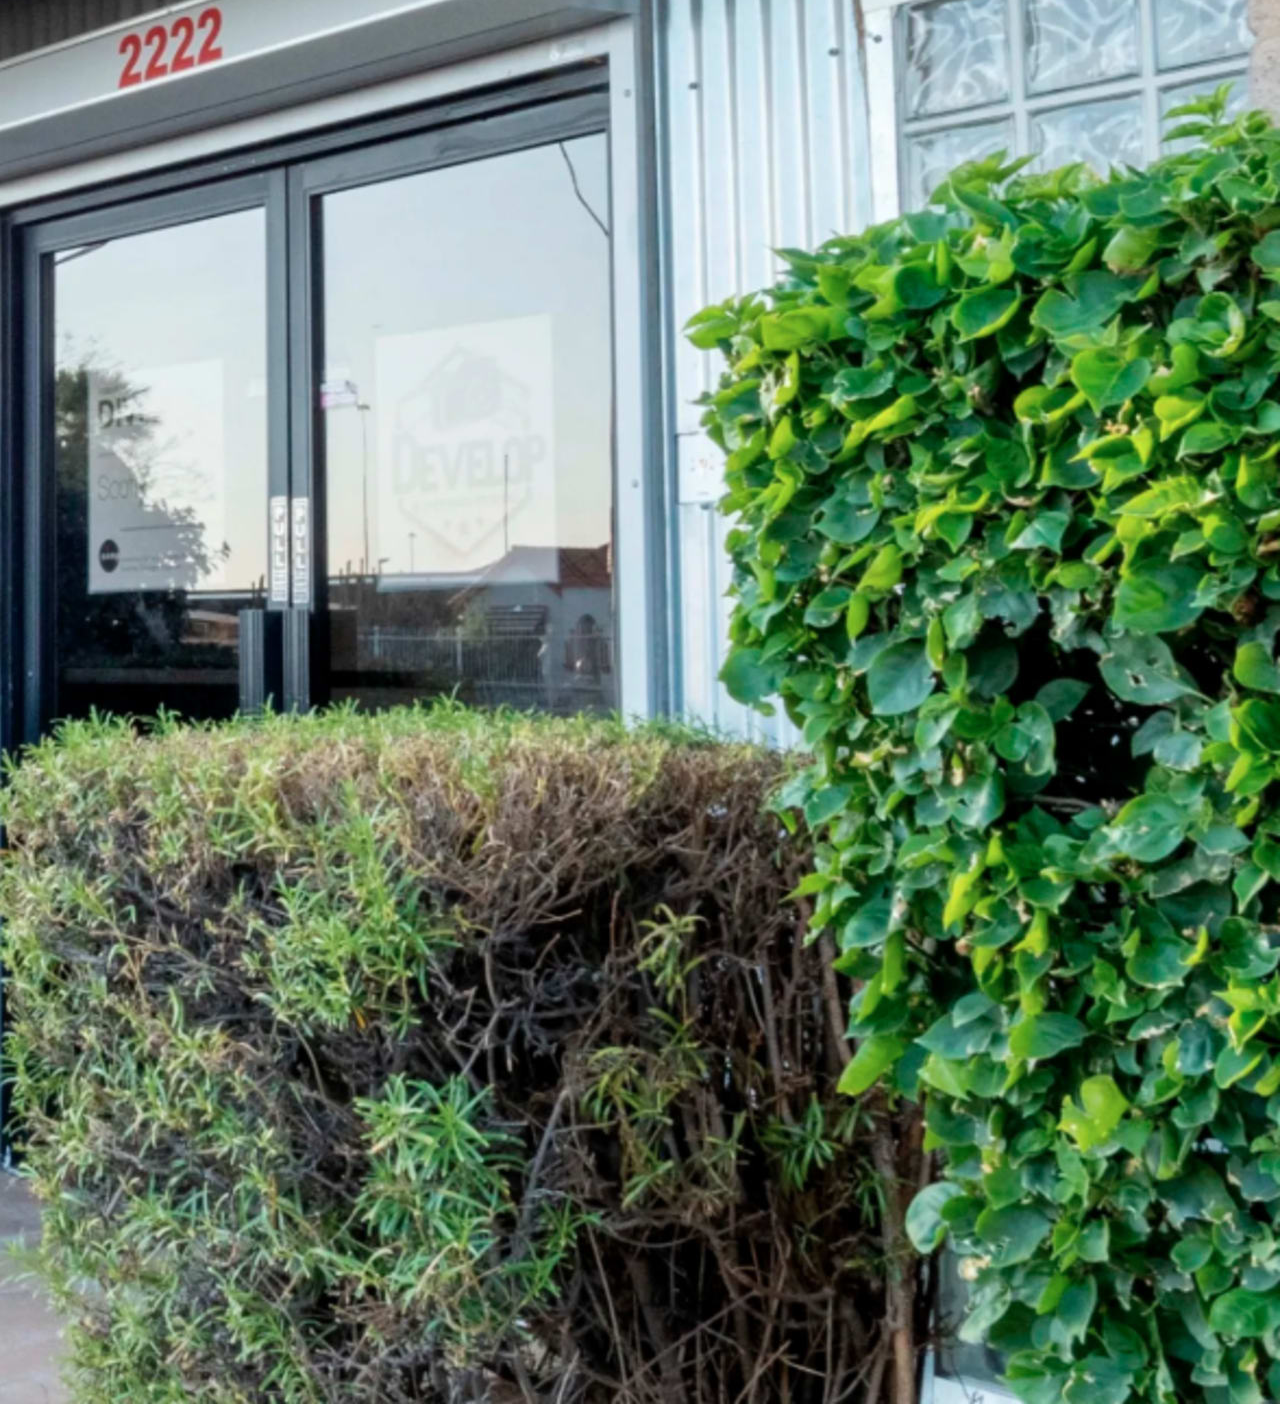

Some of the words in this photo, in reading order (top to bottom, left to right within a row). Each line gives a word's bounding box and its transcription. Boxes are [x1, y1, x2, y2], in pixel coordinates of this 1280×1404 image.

[118, 7, 222, 89] 2222
[392, 433, 546, 495] DEVELOP
[274, 505, 285, 569] PULL
[295, 507, 307, 571] PULL
